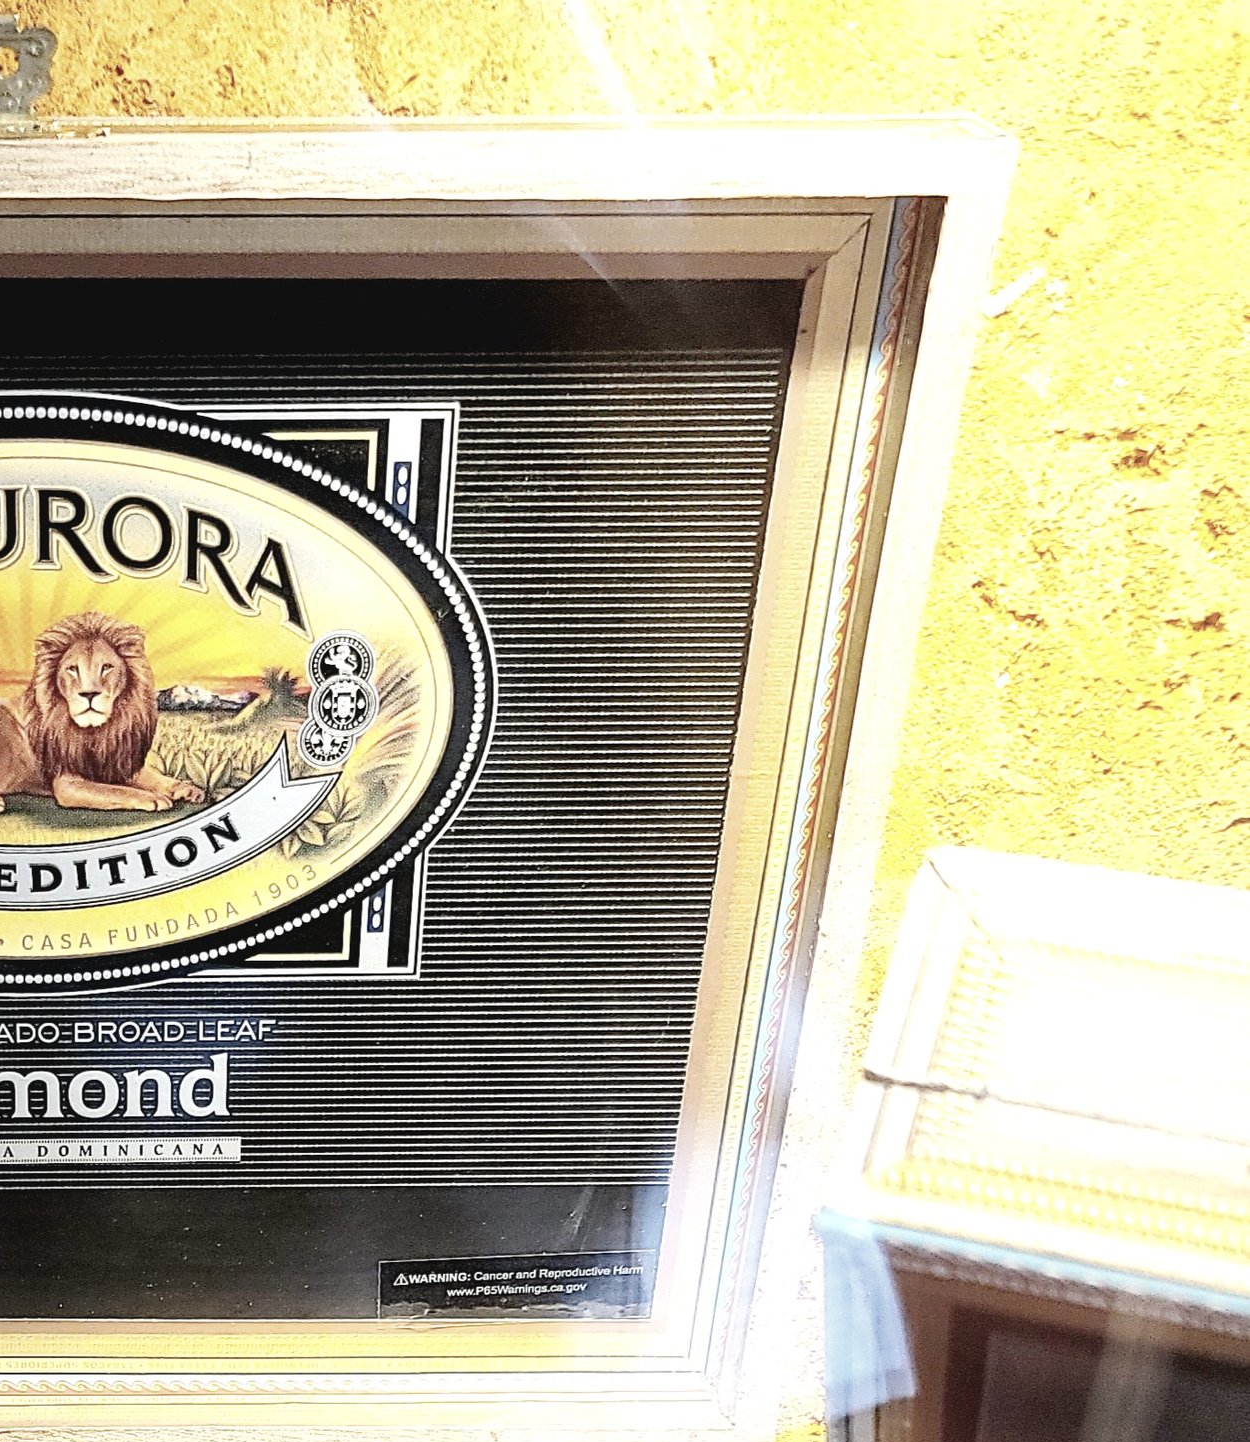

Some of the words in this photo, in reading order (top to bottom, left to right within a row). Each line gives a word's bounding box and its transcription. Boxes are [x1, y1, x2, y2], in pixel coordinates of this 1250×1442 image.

[21, 930, 92, 951] CASA
[107, 901, 240, 947] FUNDADA
[251, 862, 319, 907] 1903
[74, 1021, 185, 1043] BROAD
[198, 1019, 277, 1042] LEAF
[37, 1142, 225, 1158] DOMINICANA
[409, 1273, 471, 1284] WARNING:
[474, 1271, 512, 1281] Cancer
[516, 1270, 536, 1280] and
[539, 1267, 610, 1280] Reproductive
[613, 1266, 643, 1275] Harm
[447, 1282, 587, 1297] www.P65Warnings.ca.gov
